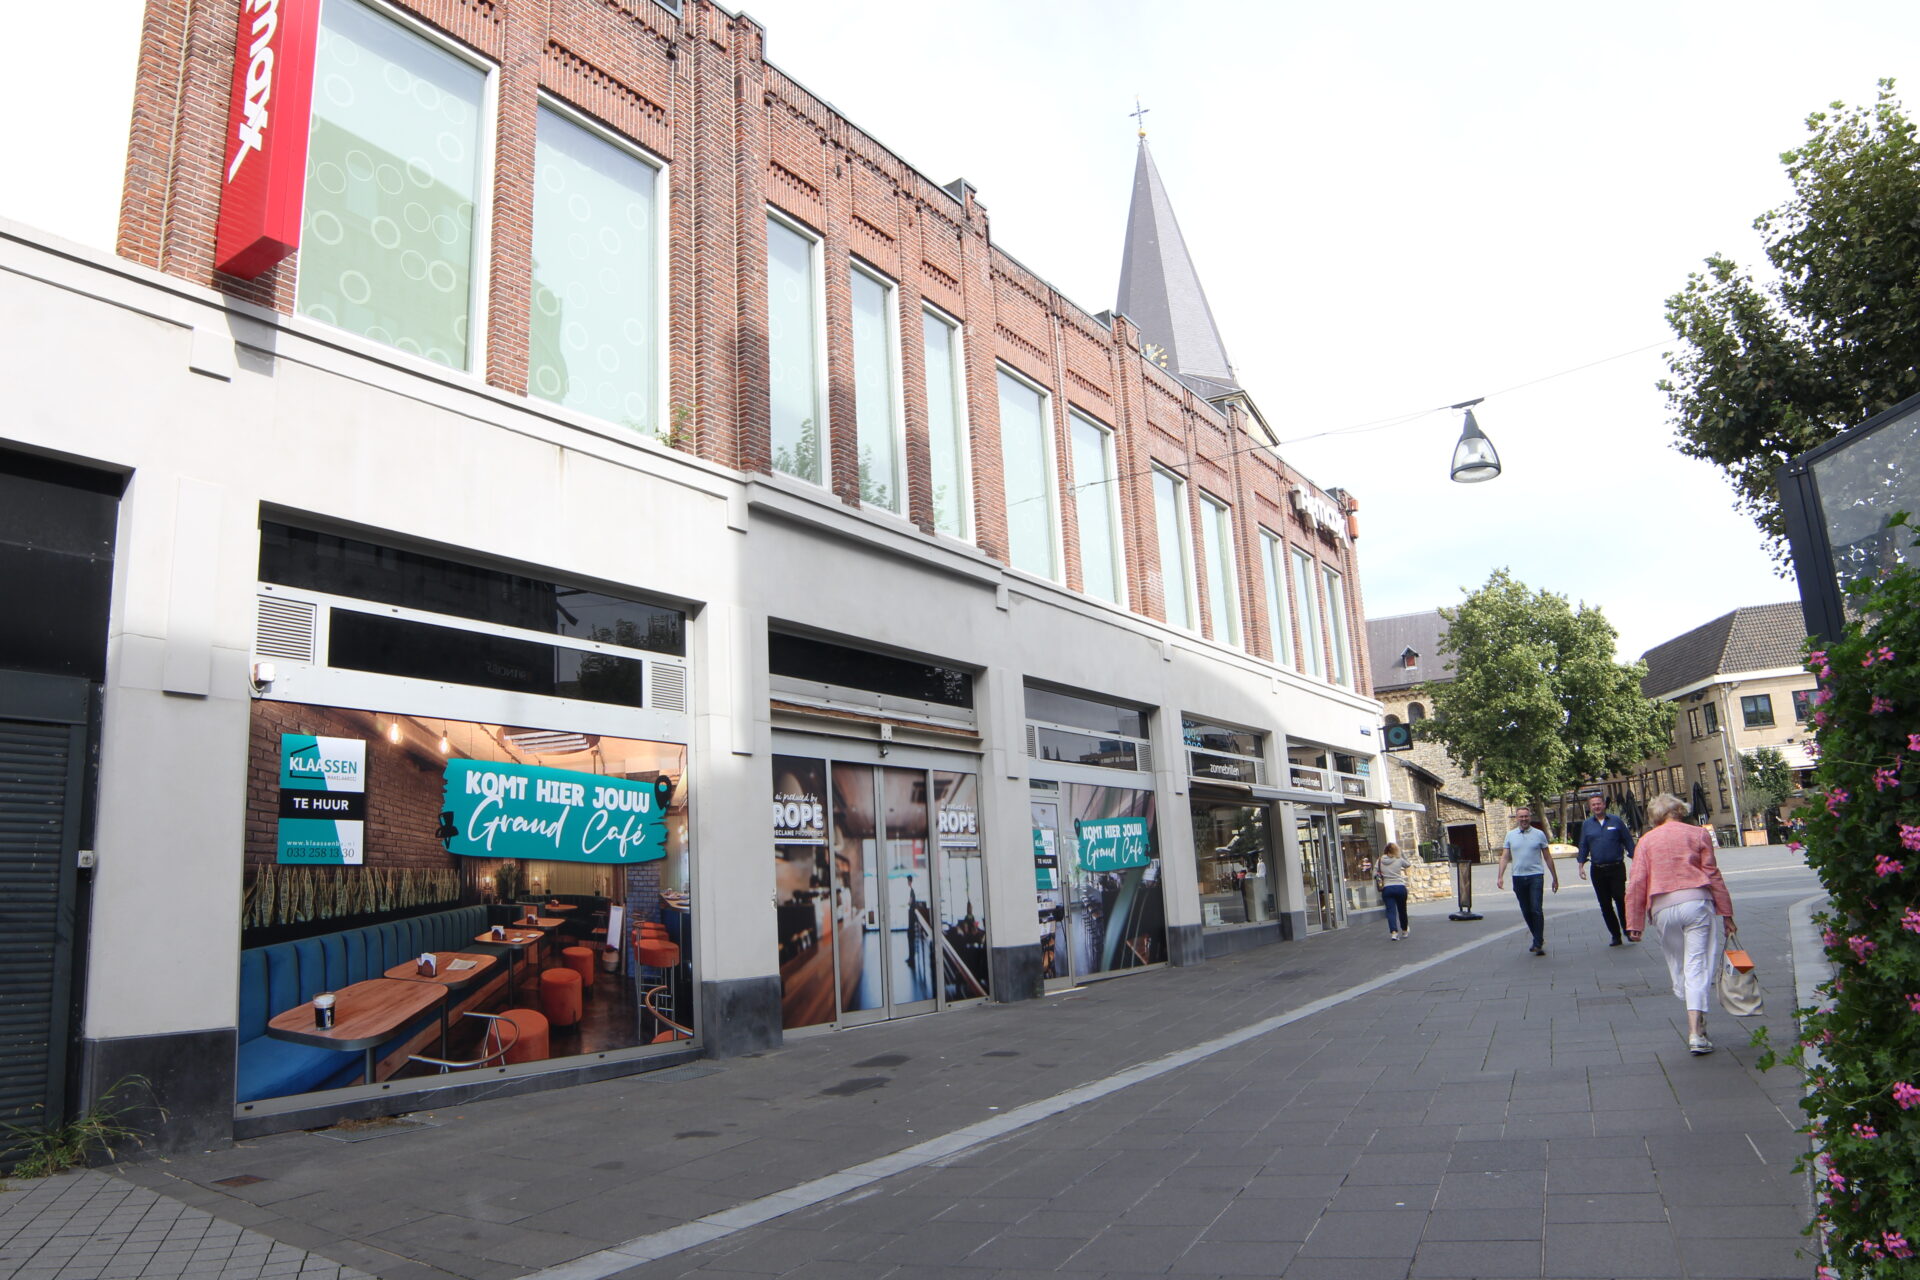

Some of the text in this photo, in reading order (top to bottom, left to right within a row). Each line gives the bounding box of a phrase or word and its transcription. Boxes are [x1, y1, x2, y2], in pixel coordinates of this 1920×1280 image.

[290, 757, 358, 774] KLAASSEN
[465, 770, 650, 813] KOMT HIER JOUW
[293, 797, 349, 810] TE HUUR
[467, 796, 646, 858] Grand Café
[938, 811, 976, 833] ROPE
[1082, 823, 1142, 840] KOMT HIER JOUW
[286, 847, 355, 858] 033 258 13 30
[1086, 837, 1143, 870] Grand Café
